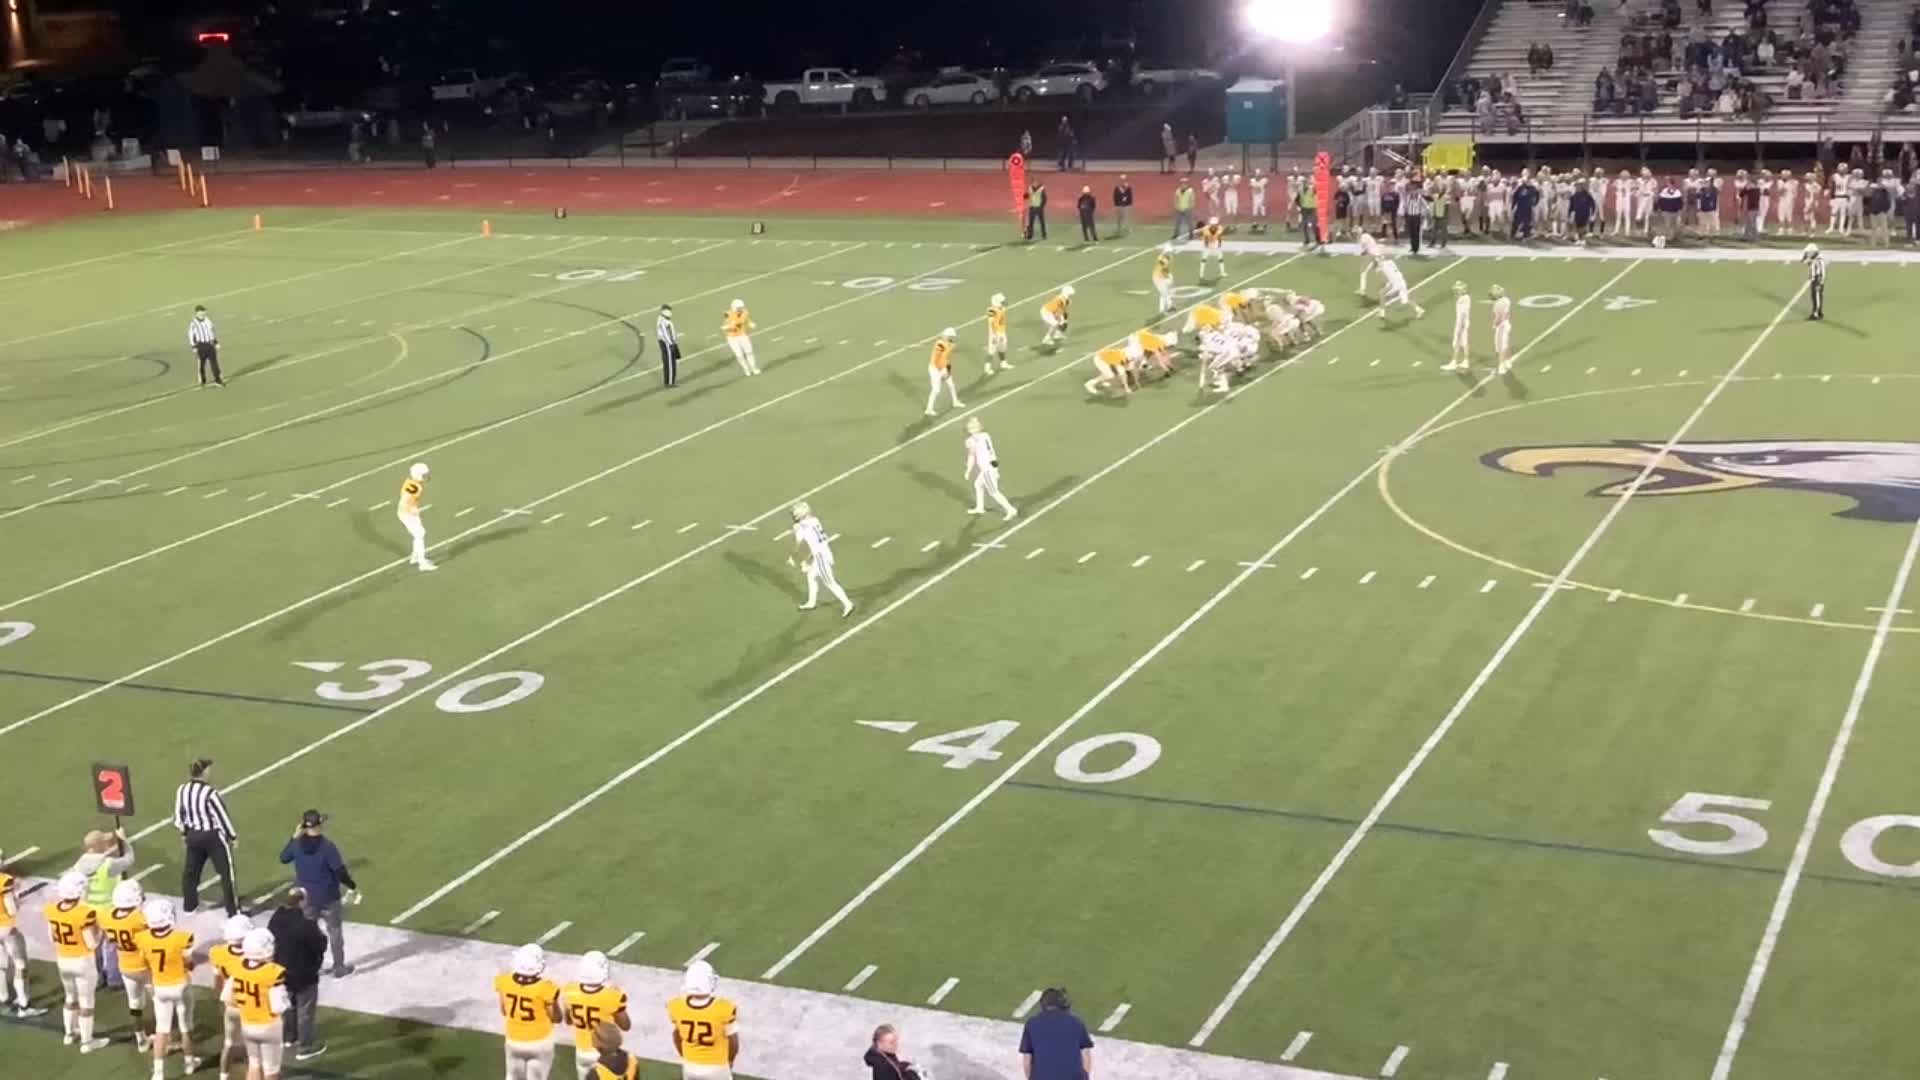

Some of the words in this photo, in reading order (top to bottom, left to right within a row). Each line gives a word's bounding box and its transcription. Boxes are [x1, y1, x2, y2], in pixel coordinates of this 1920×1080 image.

[315, 659, 545, 713] 30
[907, 719, 1161, 783] 40
[99, 770, 125, 808] 2
[1647, 792, 1920, 877] 50
[50, 920, 78, 945] 32
[151, 949, 166, 973] 7
[232, 977, 261, 1008] 24
[505, 993, 536, 1022] 75
[681, 1020, 714, 1046] 72
